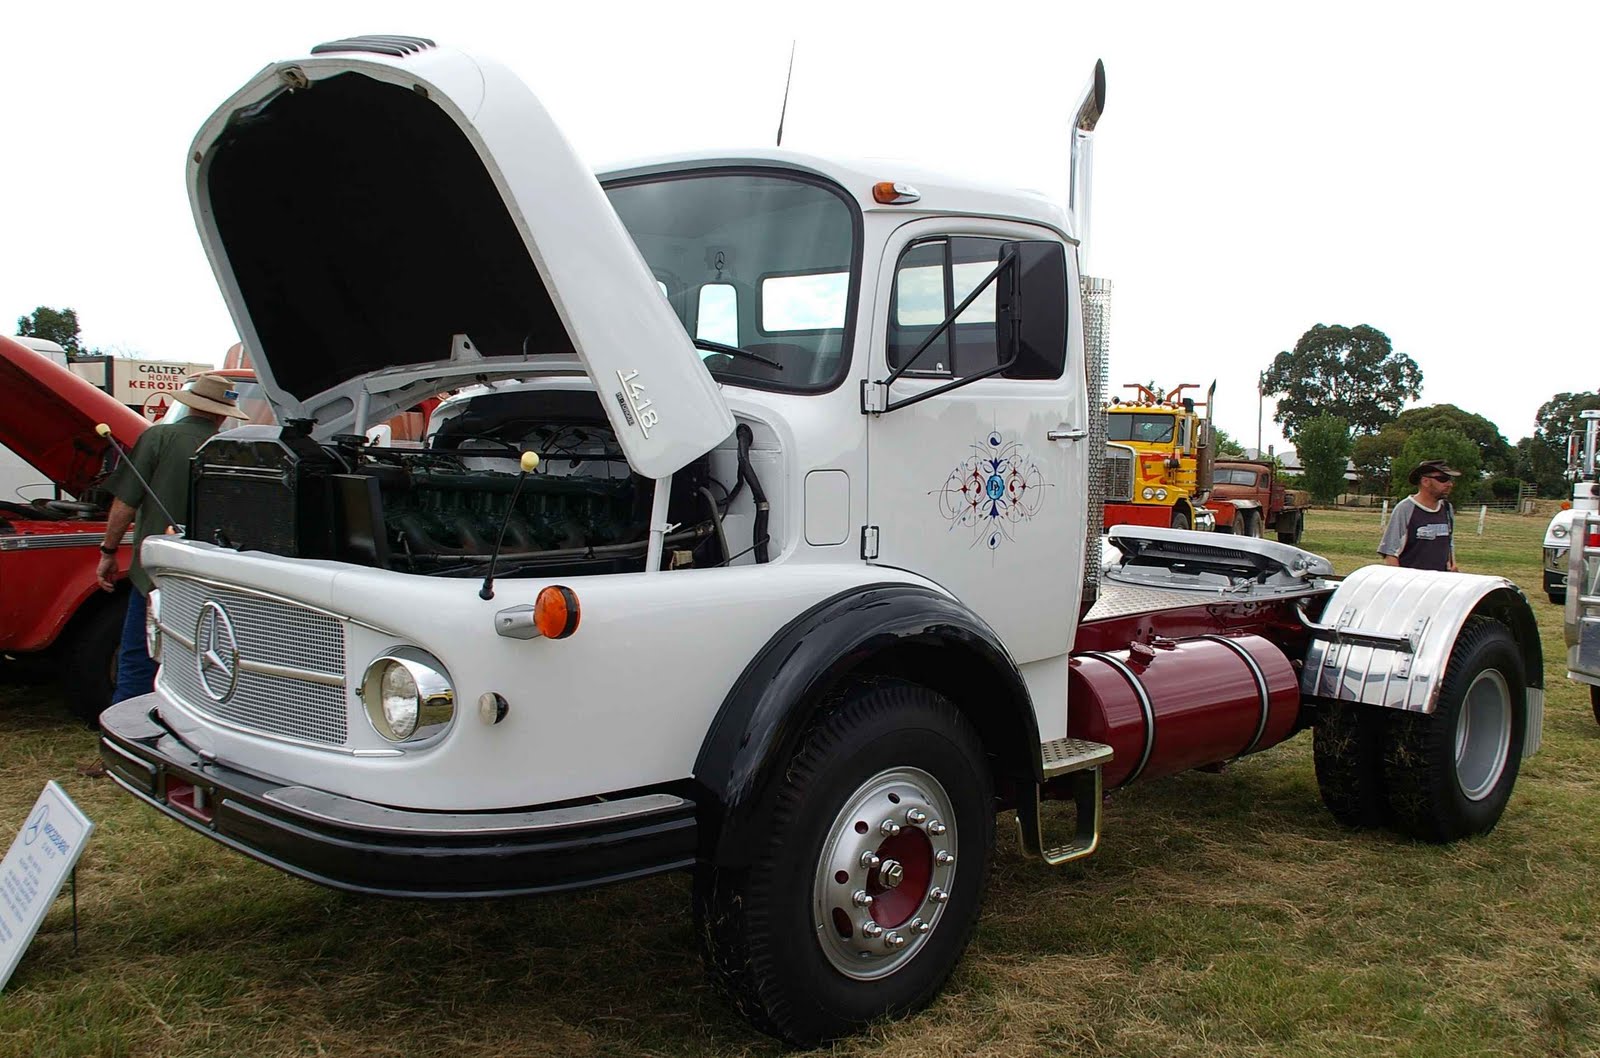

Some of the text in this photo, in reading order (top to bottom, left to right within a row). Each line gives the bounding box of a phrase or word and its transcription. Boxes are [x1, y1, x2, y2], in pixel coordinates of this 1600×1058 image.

[139, 364, 187, 376] CALTEX
[148, 373, 178, 382] HOME
[624, 369, 658, 429] 1418
